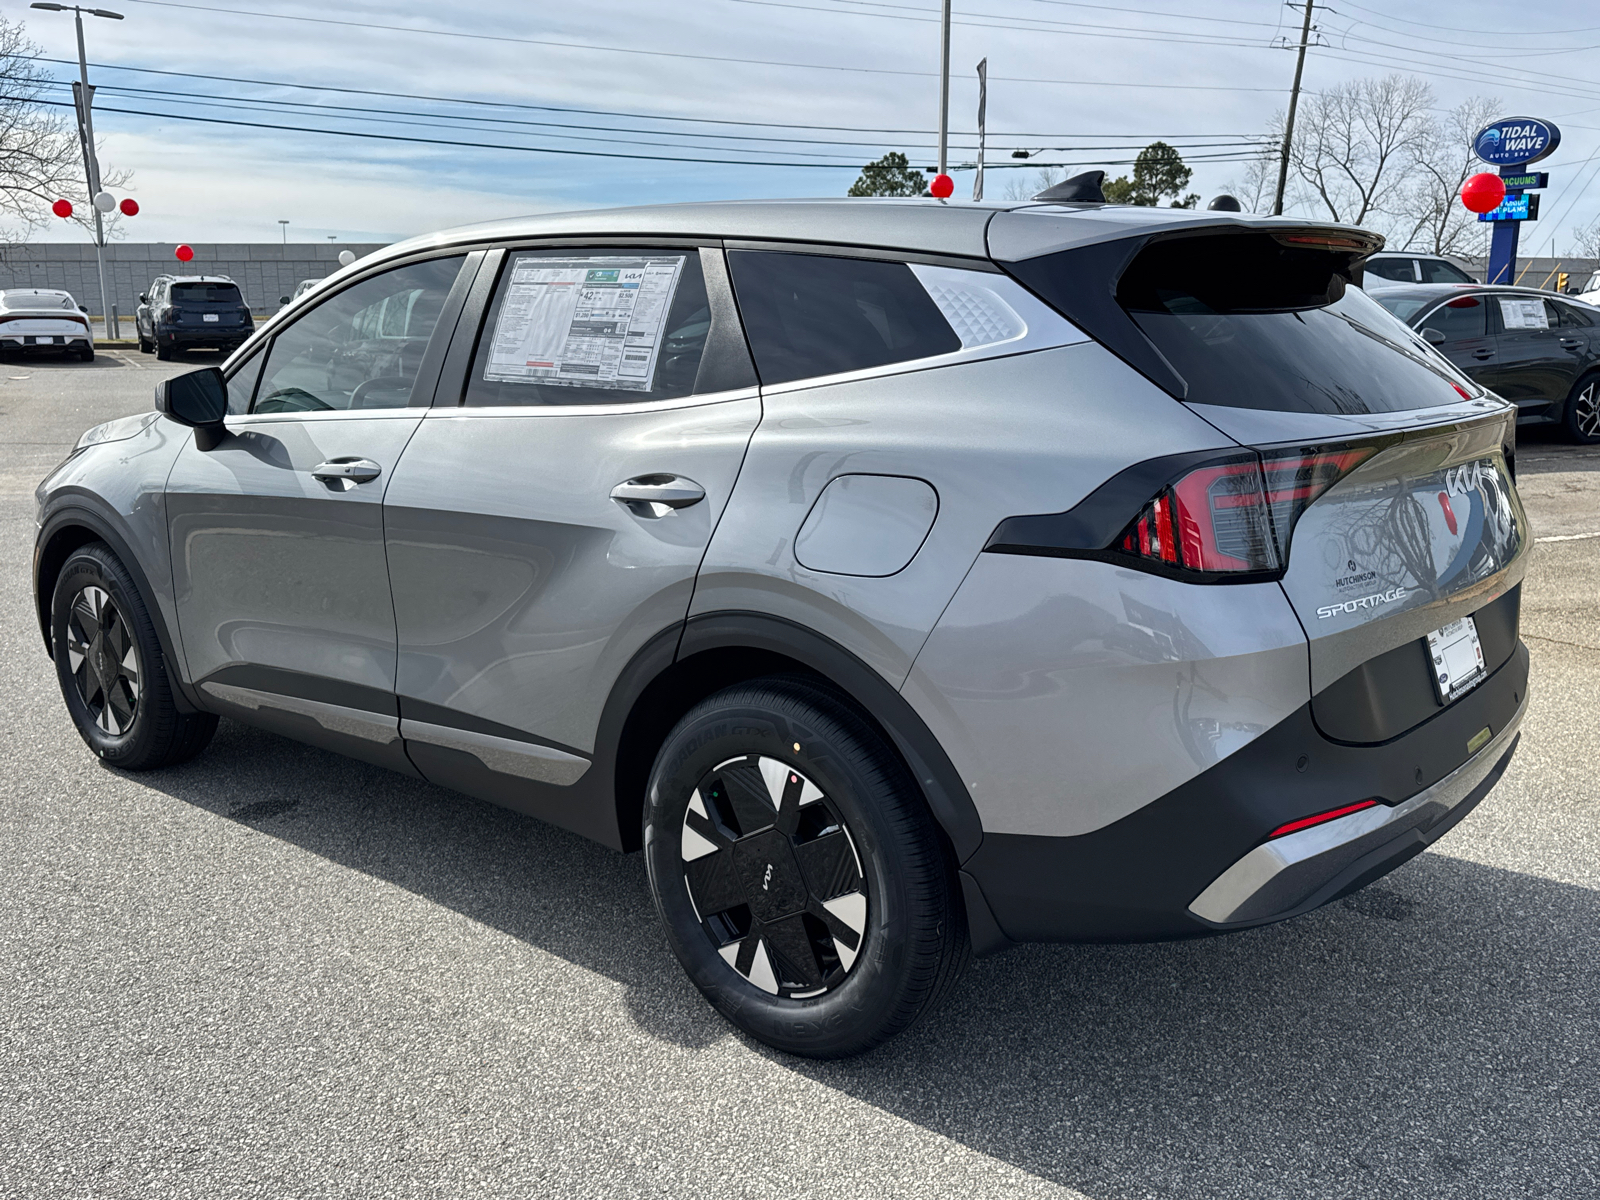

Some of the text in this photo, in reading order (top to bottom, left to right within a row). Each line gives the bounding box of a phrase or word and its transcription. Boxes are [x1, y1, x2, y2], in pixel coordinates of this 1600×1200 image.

[1501, 125, 1537, 139] TIDAL
[1505, 137, 1544, 151] WAVE
[1502, 175, 1536, 186] ACUUMS
[583, 291, 594, 300] 42
[1445, 461, 1483, 498] KIA
[1335, 571, 1377, 588] HUTCHINSON
[1316, 587, 1406, 619] SPORTAGE
